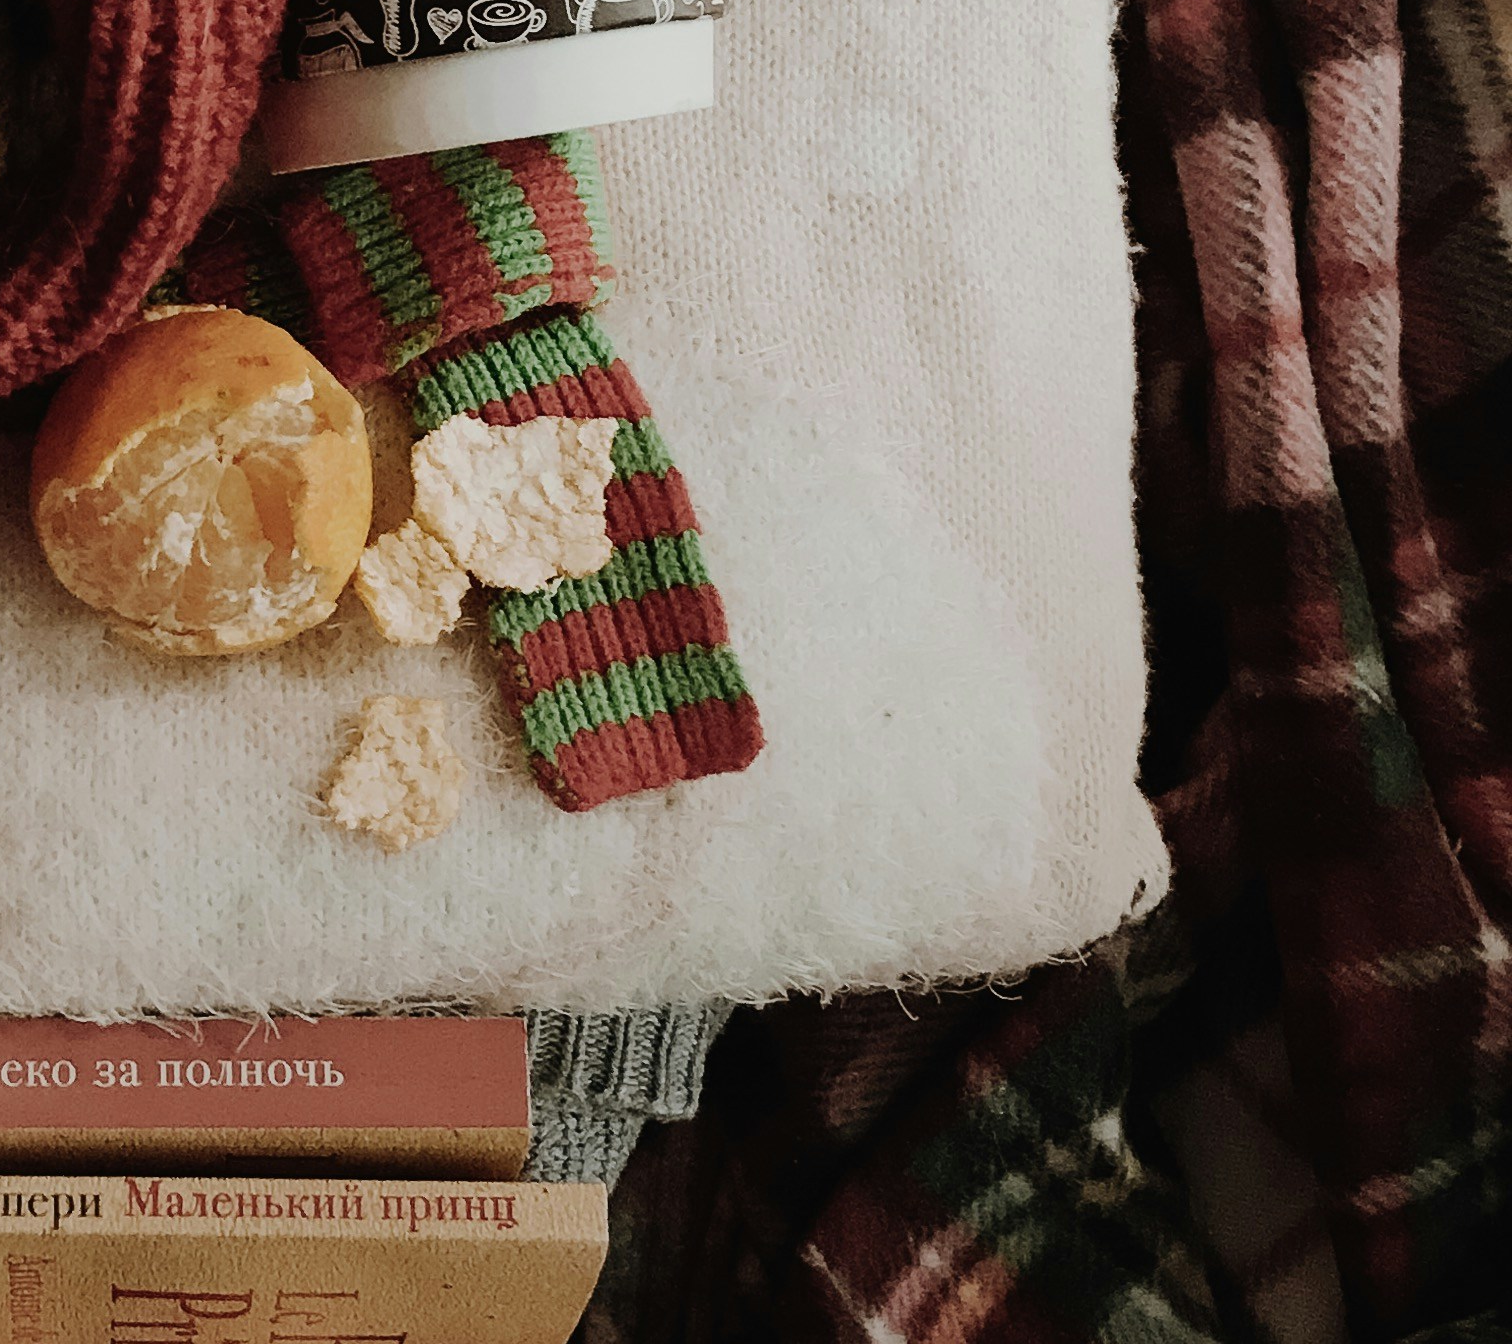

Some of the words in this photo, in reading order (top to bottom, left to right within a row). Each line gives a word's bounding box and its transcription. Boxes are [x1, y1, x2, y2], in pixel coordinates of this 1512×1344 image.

[93, 1058, 143, 1090] за
[157, 1056, 345, 1092] полночь
[124, 1177, 365, 1222] Маленький
[380, 1189, 517, 1233] принц
